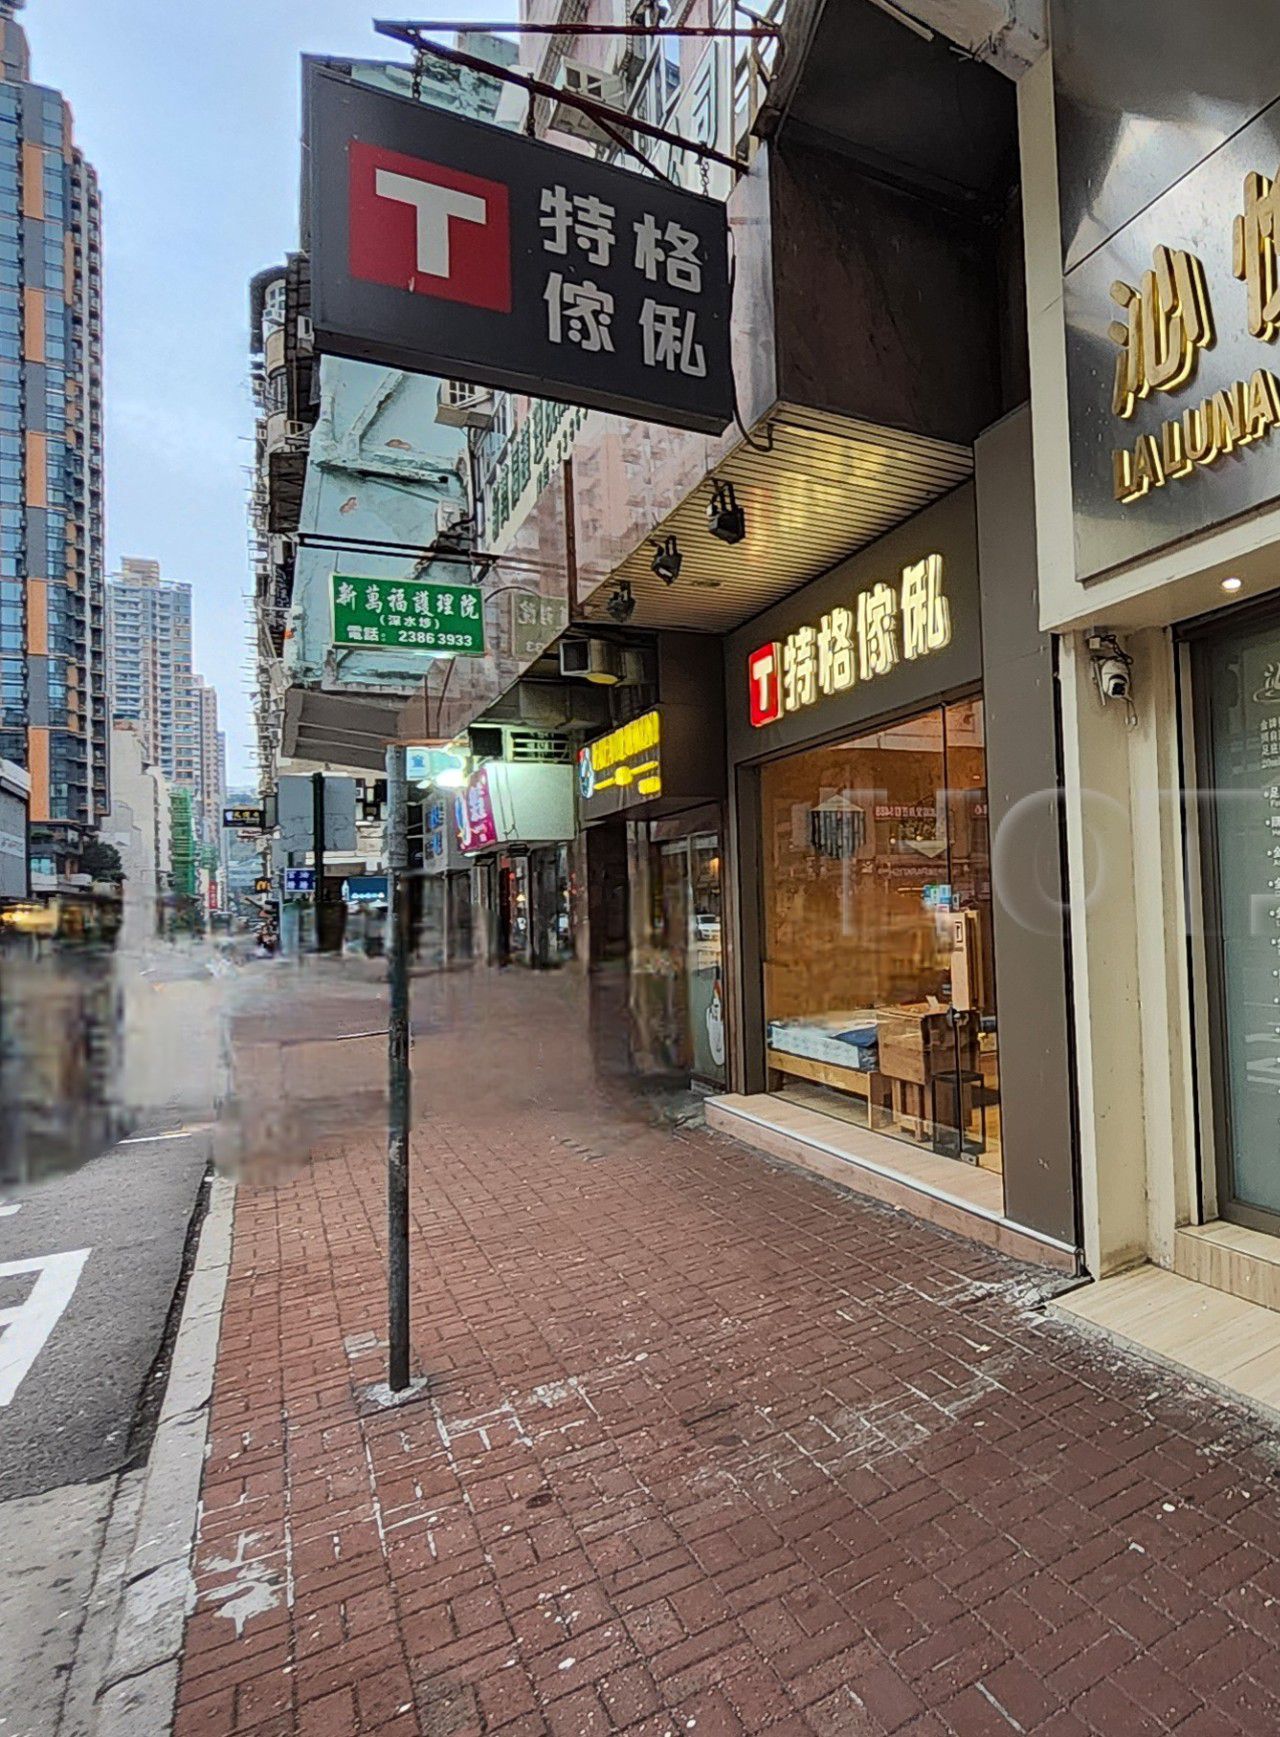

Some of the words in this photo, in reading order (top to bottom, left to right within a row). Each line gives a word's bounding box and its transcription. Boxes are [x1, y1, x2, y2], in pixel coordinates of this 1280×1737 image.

[375, 168, 486, 278] T
[539, 184, 702, 294] 特格
[543, 271, 708, 377] 傢俬
[336, 582, 480, 619] 新萬福護理院
[398, 630, 435, 644] 2386
[437, 634, 472, 647] 3933
[784, 554, 951, 712] 特格傢俬
